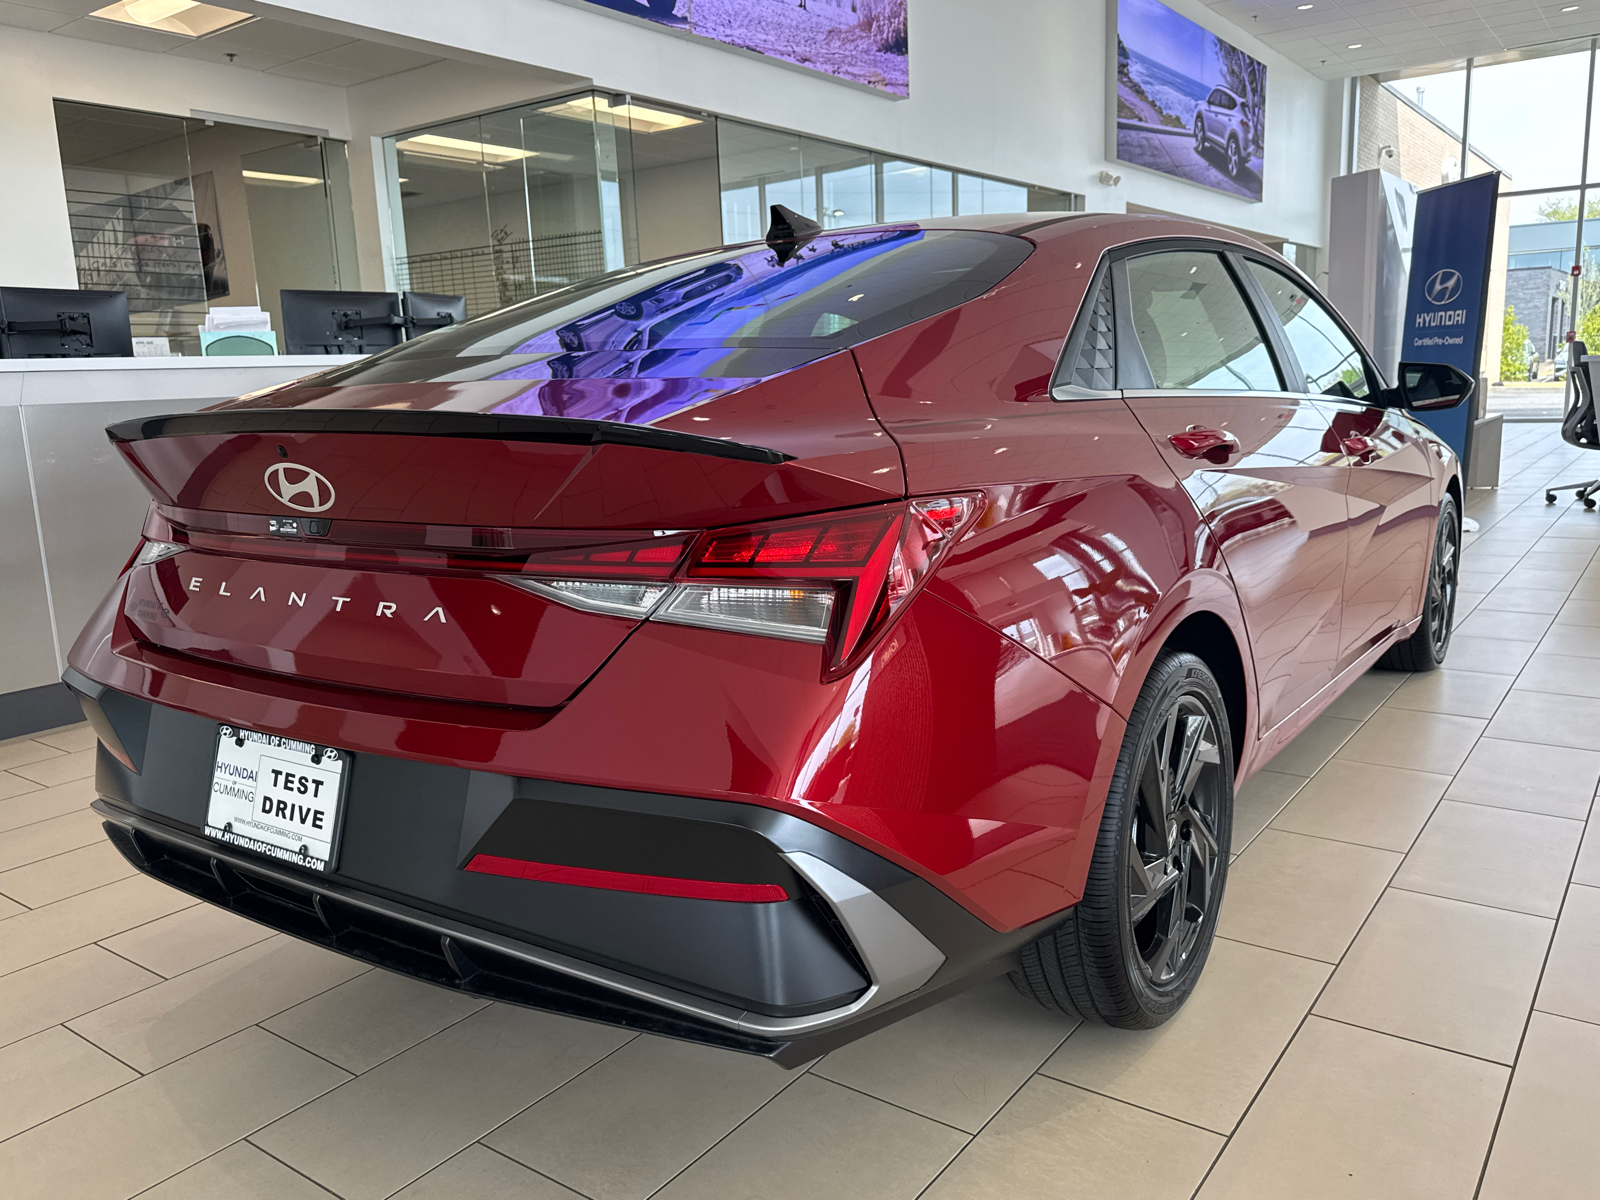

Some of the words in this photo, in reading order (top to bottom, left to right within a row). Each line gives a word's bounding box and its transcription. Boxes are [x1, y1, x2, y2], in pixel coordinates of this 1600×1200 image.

[1416, 309, 1466, 328] HYUNDAI
[188, 576, 447, 624] ELANTRA
[239, 729, 270, 745] HYUNDAI
[270, 736, 280, 746] OF
[281, 738, 316, 755] CUMMING
[215, 760, 258, 782] HYUNDAI
[271, 768, 324, 798] TEST
[213, 781, 255, 803] CUMMING
[261, 795, 325, 830] DRIVE
[233, 816, 303, 842] WWW.HYUNDAIOFCUMMING.COM
[204, 825, 325, 872] WWW.HYUNDAIOFCUMMING.COM
